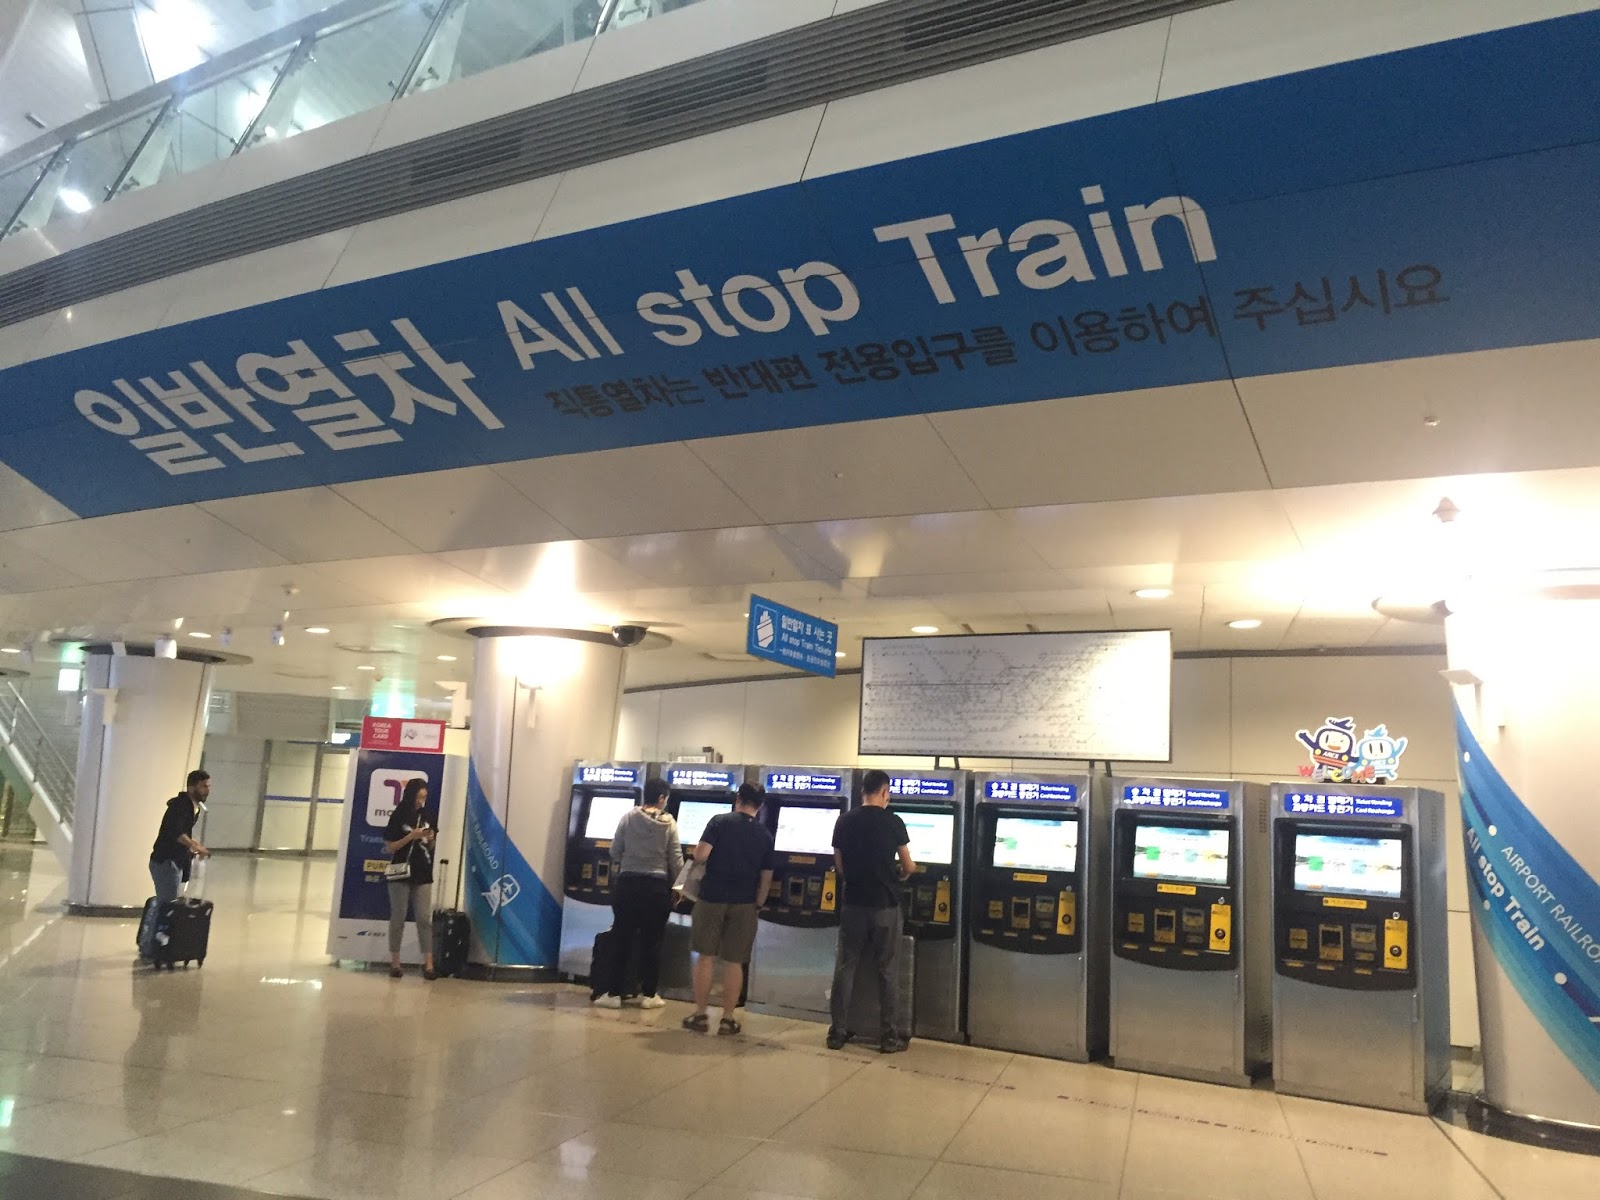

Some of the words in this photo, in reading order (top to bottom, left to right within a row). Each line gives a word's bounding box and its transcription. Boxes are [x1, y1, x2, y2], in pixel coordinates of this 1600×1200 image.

[496, 286, 625, 371] All
[636, 260, 861, 348] stop
[872, 184, 1217, 304] Train
[73, 317, 506, 476] 일반열차
[702, 353, 818, 402] 반대편
[816, 325, 1018, 385] 전용입구를
[1029, 293, 1218, 357] 이용하여
[1298, 765, 1375, 783] WELCOME
[1466, 827, 1481, 854] All
[1478, 854, 1505, 899] stop
[1504, 895, 1546, 952] Train
[1501, 845, 1556, 905] AIRPORT
